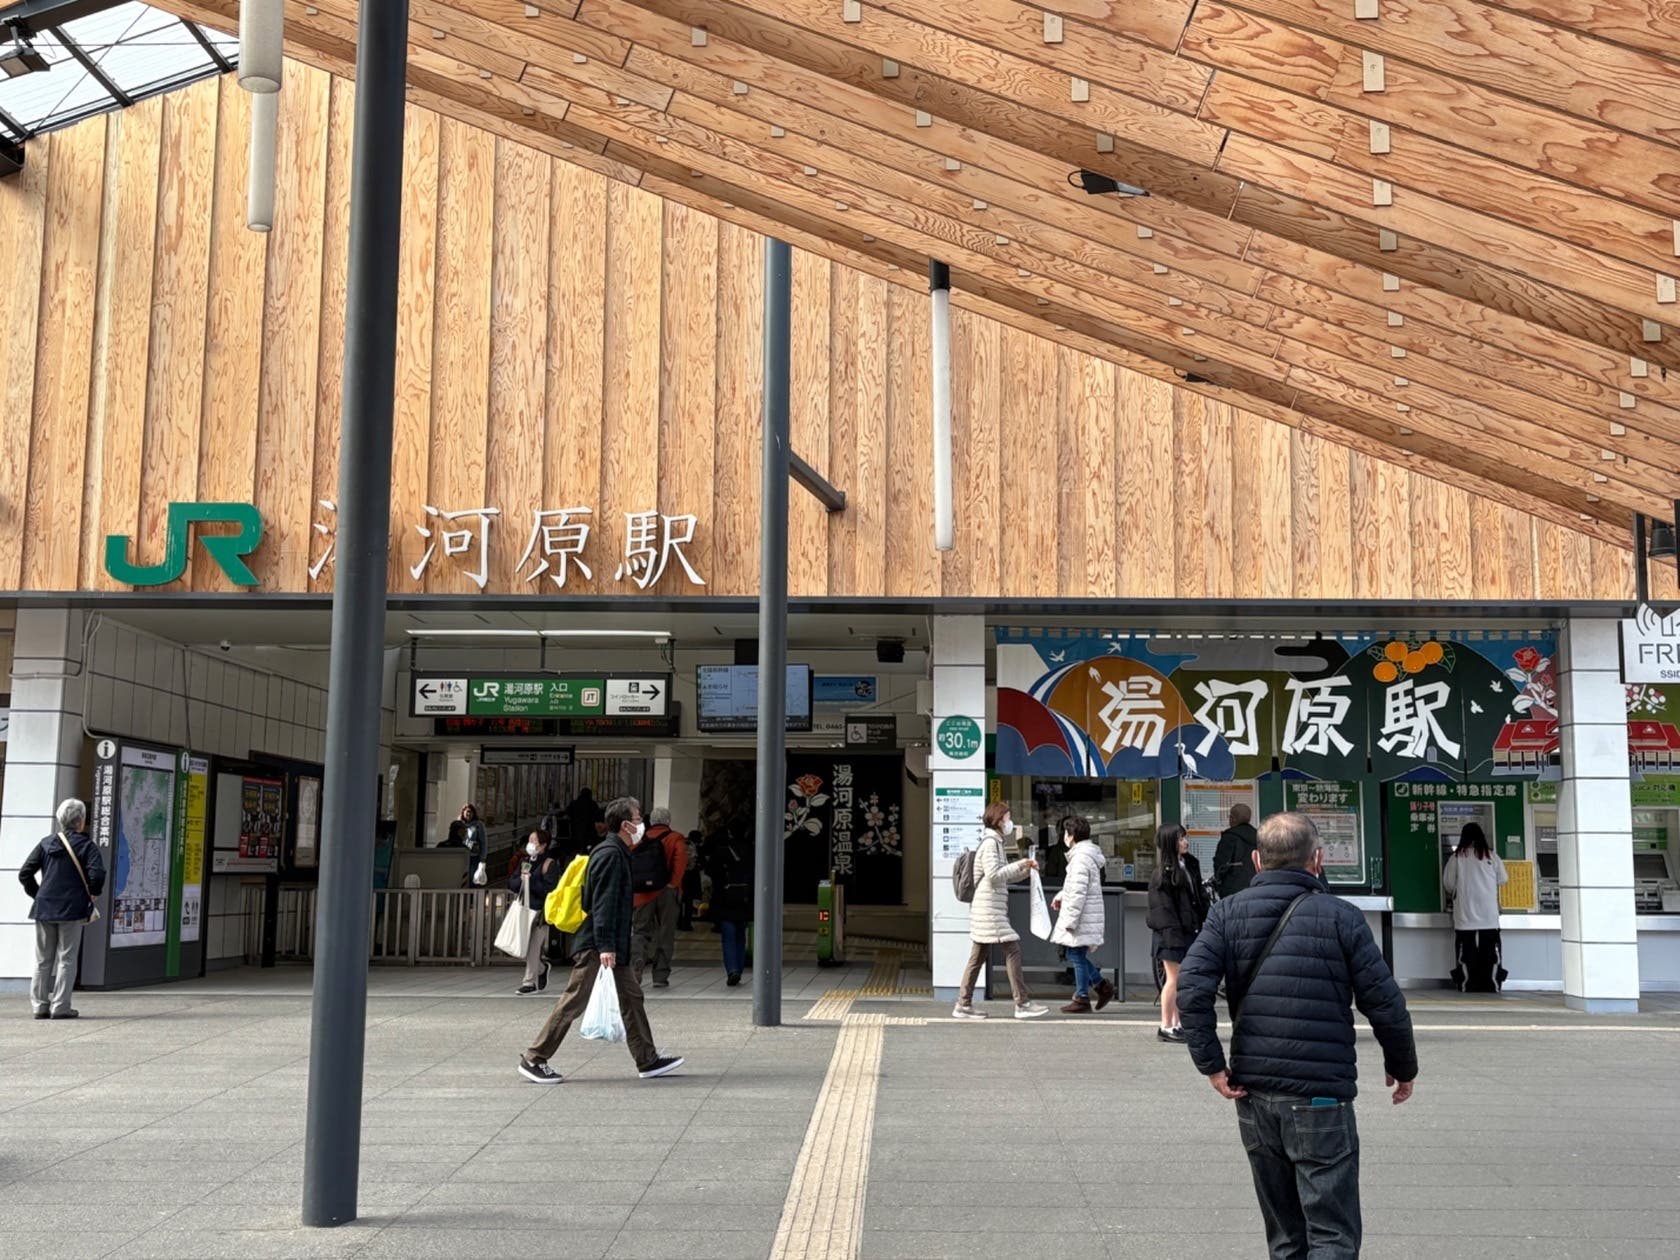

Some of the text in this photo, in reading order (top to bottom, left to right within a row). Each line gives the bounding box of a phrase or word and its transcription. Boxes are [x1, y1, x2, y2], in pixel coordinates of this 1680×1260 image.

[105, 502, 264, 587] JR
[1639, 643, 1680, 664] FR
[473, 682, 500, 697] JR
[504, 682, 544, 695] 湯河原駅
[550, 683, 568, 692] 入口
[504, 696, 539, 705] Yugawara
[586, 693, 595, 701] JT
[503, 704, 528, 712] Station
[1098, 675, 1461, 760] 湯河原駅
[1412, 783, 1517, 797] 新幹線・特急指定席
[1297, 792, 1348, 804] 変わります
[99, 765, 114, 847] 湯河原駅総合案内
[832, 764, 854, 875] 湯河原温泉
